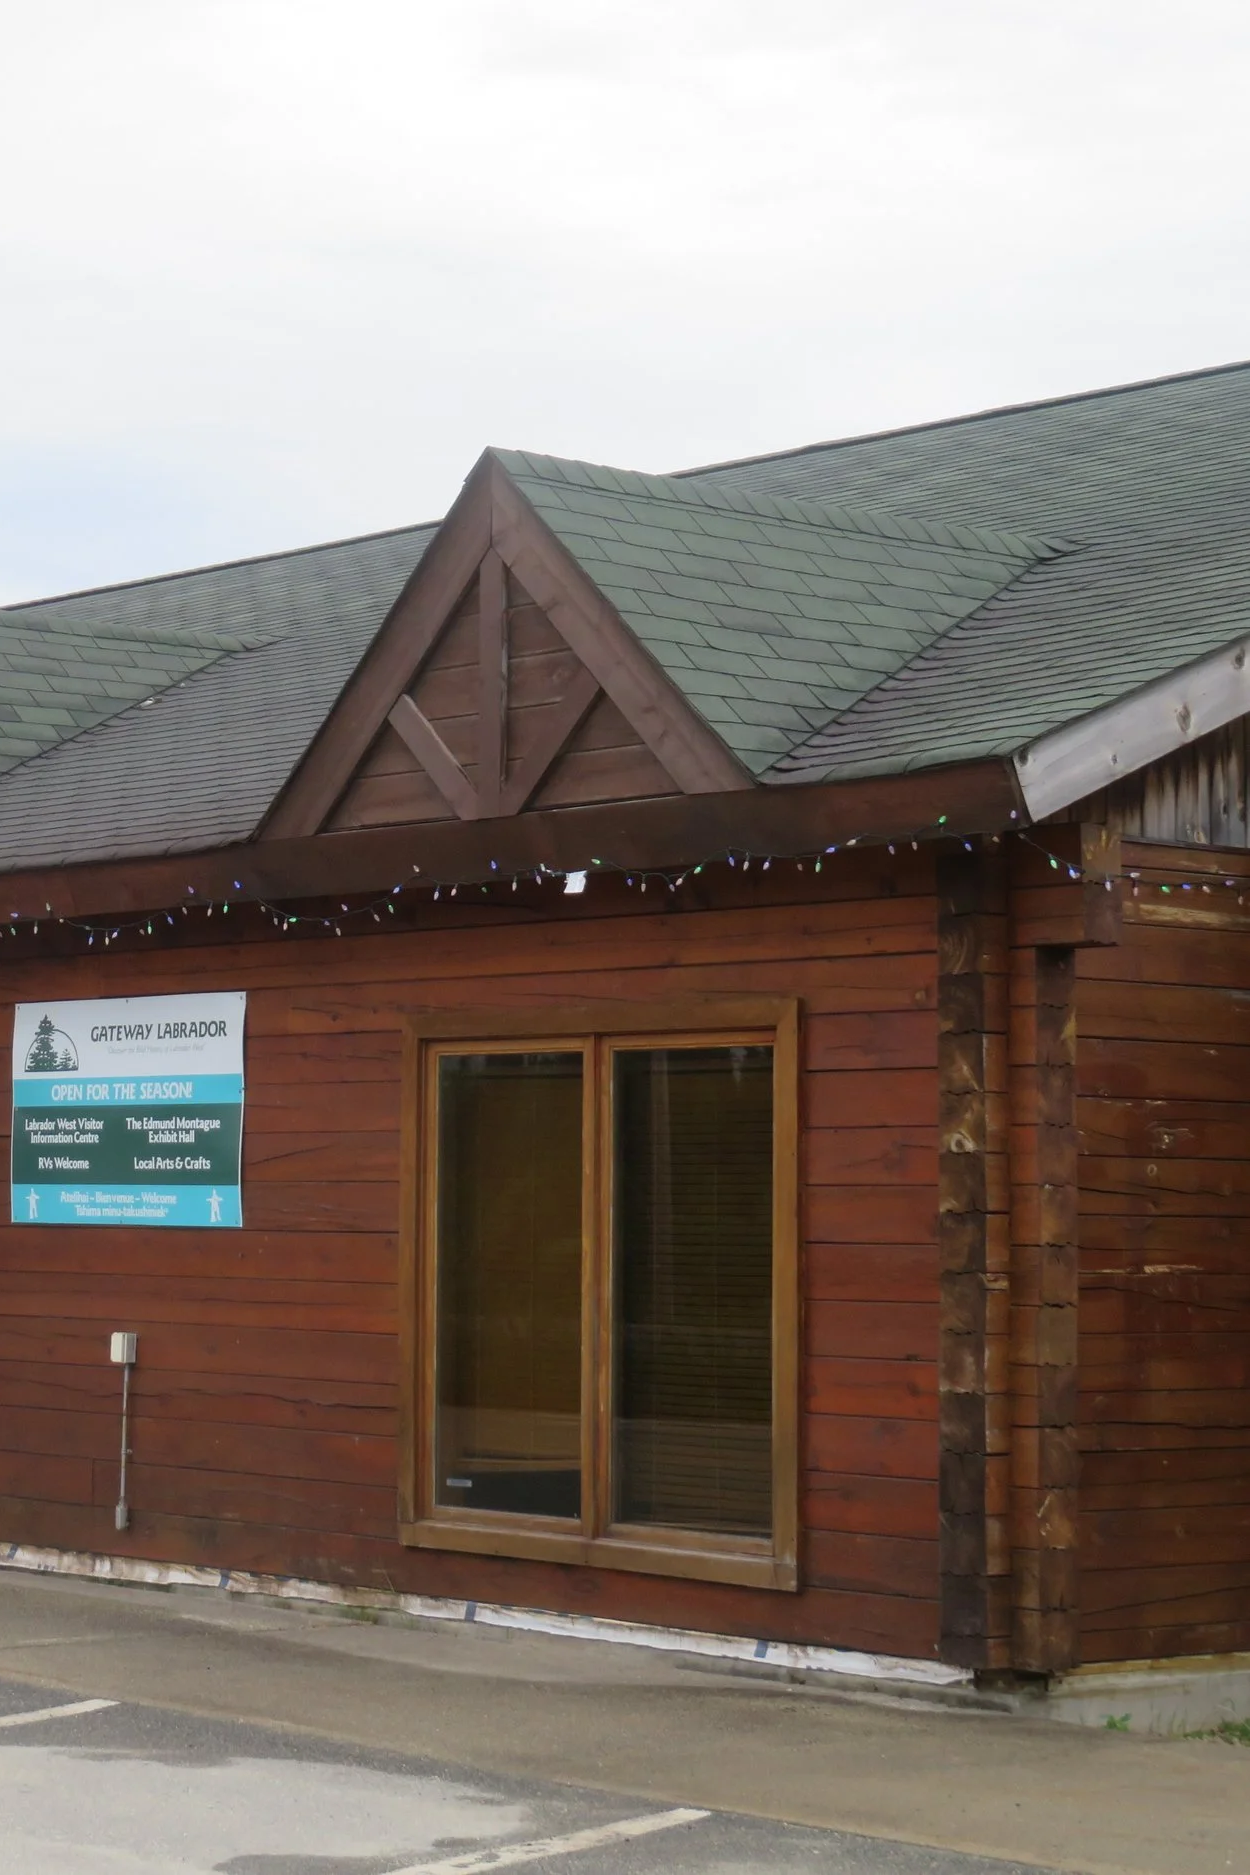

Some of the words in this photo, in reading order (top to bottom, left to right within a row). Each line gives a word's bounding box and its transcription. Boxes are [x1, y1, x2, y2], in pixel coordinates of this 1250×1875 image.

[91, 1024, 153, 1042] GATEWAY
[157, 1020, 227, 1039] LABRADOR
[51, 1084, 83, 1101] OPEN
[86, 1083, 110, 1100] FOR
[113, 1082, 136, 1099] THE
[140, 1081, 193, 1099] SEASON!
[25, 1118, 56, 1131] Labrador
[56, 1118, 77, 1130] West
[77, 1117, 104, 1130] Visitor
[126, 1117, 142, 1130] The
[143, 1116, 176, 1130] Edmund
[176, 1116, 221, 1132] Montague
[30, 1131, 73, 1144] Information
[73, 1131, 99, 1143] Centre
[148, 1131, 178, 1143] Exhibit
[178, 1130, 195, 1143] Hall
[38, 1157, 53, 1169] RVs
[53, 1157, 90, 1169] Welcome
[134, 1157, 155, 1170] Local
[155, 1157, 175, 1170] Arts
[184, 1156, 211, 1170] Crafts
[141, 1191, 178, 1204] Welcome
